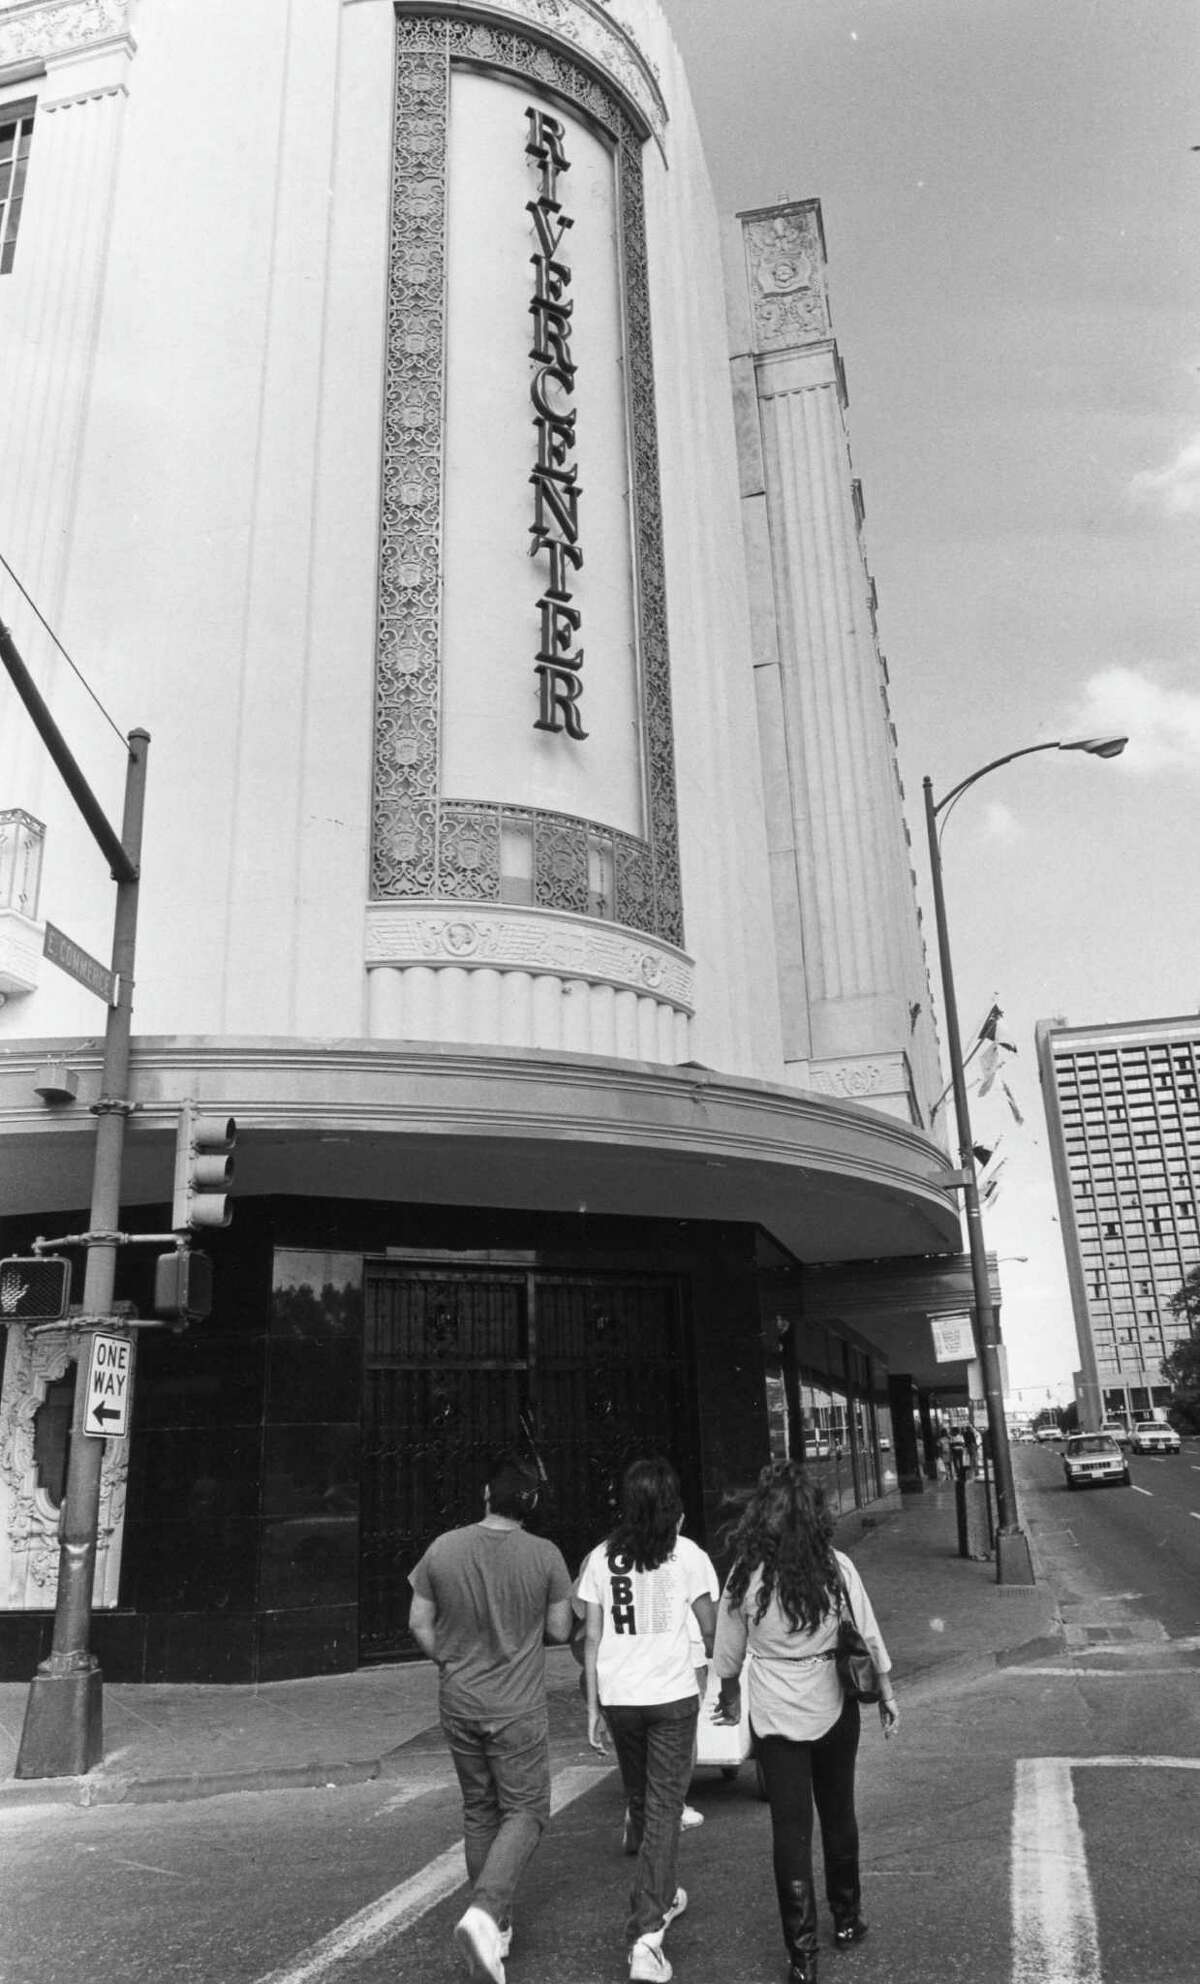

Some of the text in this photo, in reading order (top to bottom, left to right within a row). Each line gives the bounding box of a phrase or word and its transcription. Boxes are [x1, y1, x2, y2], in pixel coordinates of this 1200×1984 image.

[525, 106, 589, 740] RIVERCENTER
[60, 939, 110, 997] COMMERCE
[97, 1343, 127, 1369] ONE
[94, 1370, 126, 1396] WAY
